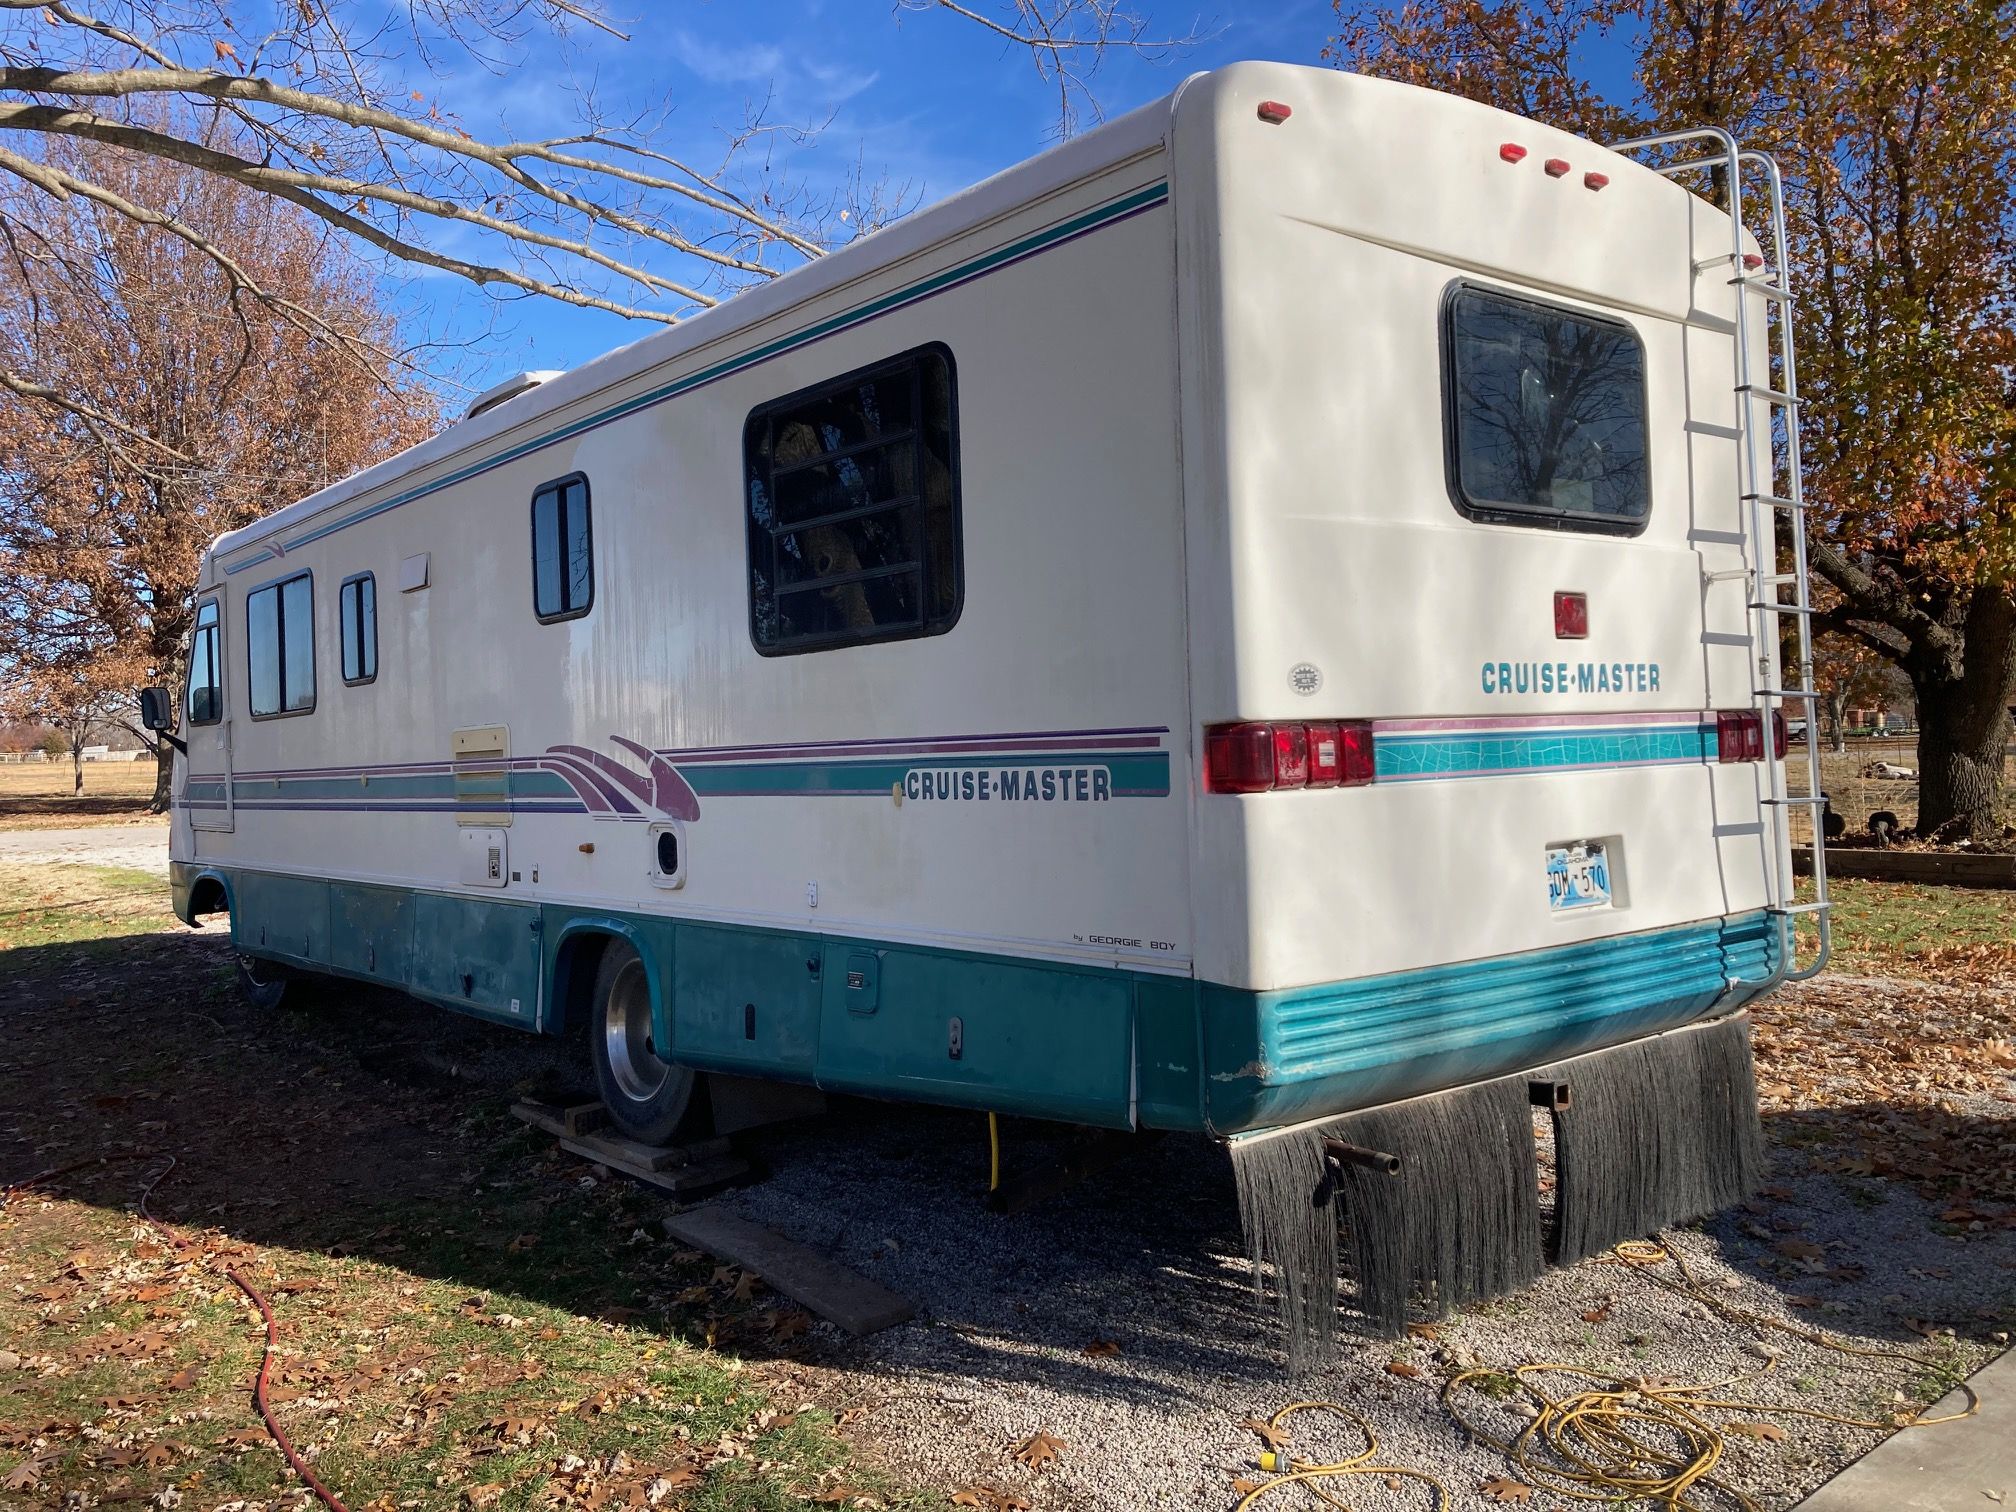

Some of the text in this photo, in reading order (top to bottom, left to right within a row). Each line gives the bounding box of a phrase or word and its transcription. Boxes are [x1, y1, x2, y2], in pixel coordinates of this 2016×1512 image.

[1481, 662, 1661, 694] CRUISE MASTER
[907, 769, 1110, 801] CRUISE MASTER
[1073, 933, 1177, 951] by GEORGIE BOY
